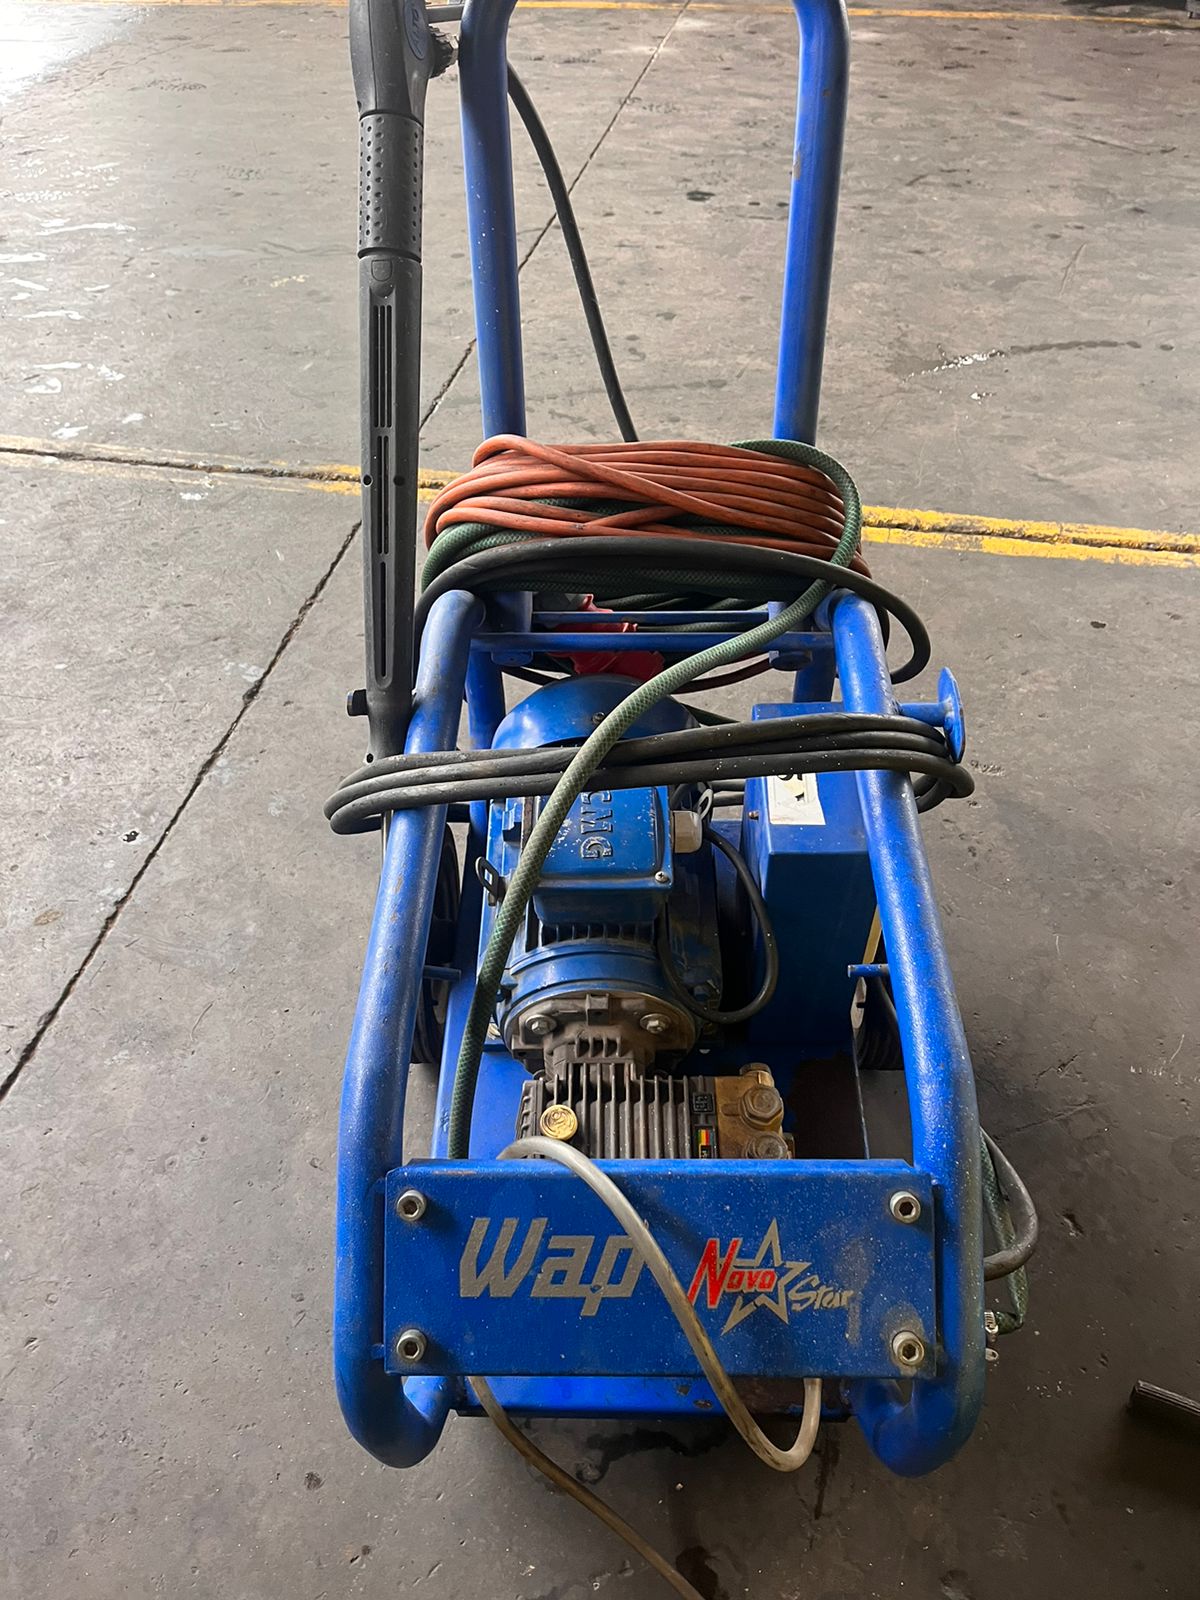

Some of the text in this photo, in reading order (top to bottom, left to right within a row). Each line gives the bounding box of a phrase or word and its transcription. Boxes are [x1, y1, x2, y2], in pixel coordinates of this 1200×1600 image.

[459, 1217, 645, 1317] Wap
[687, 1237, 853, 1312] Novo Star
